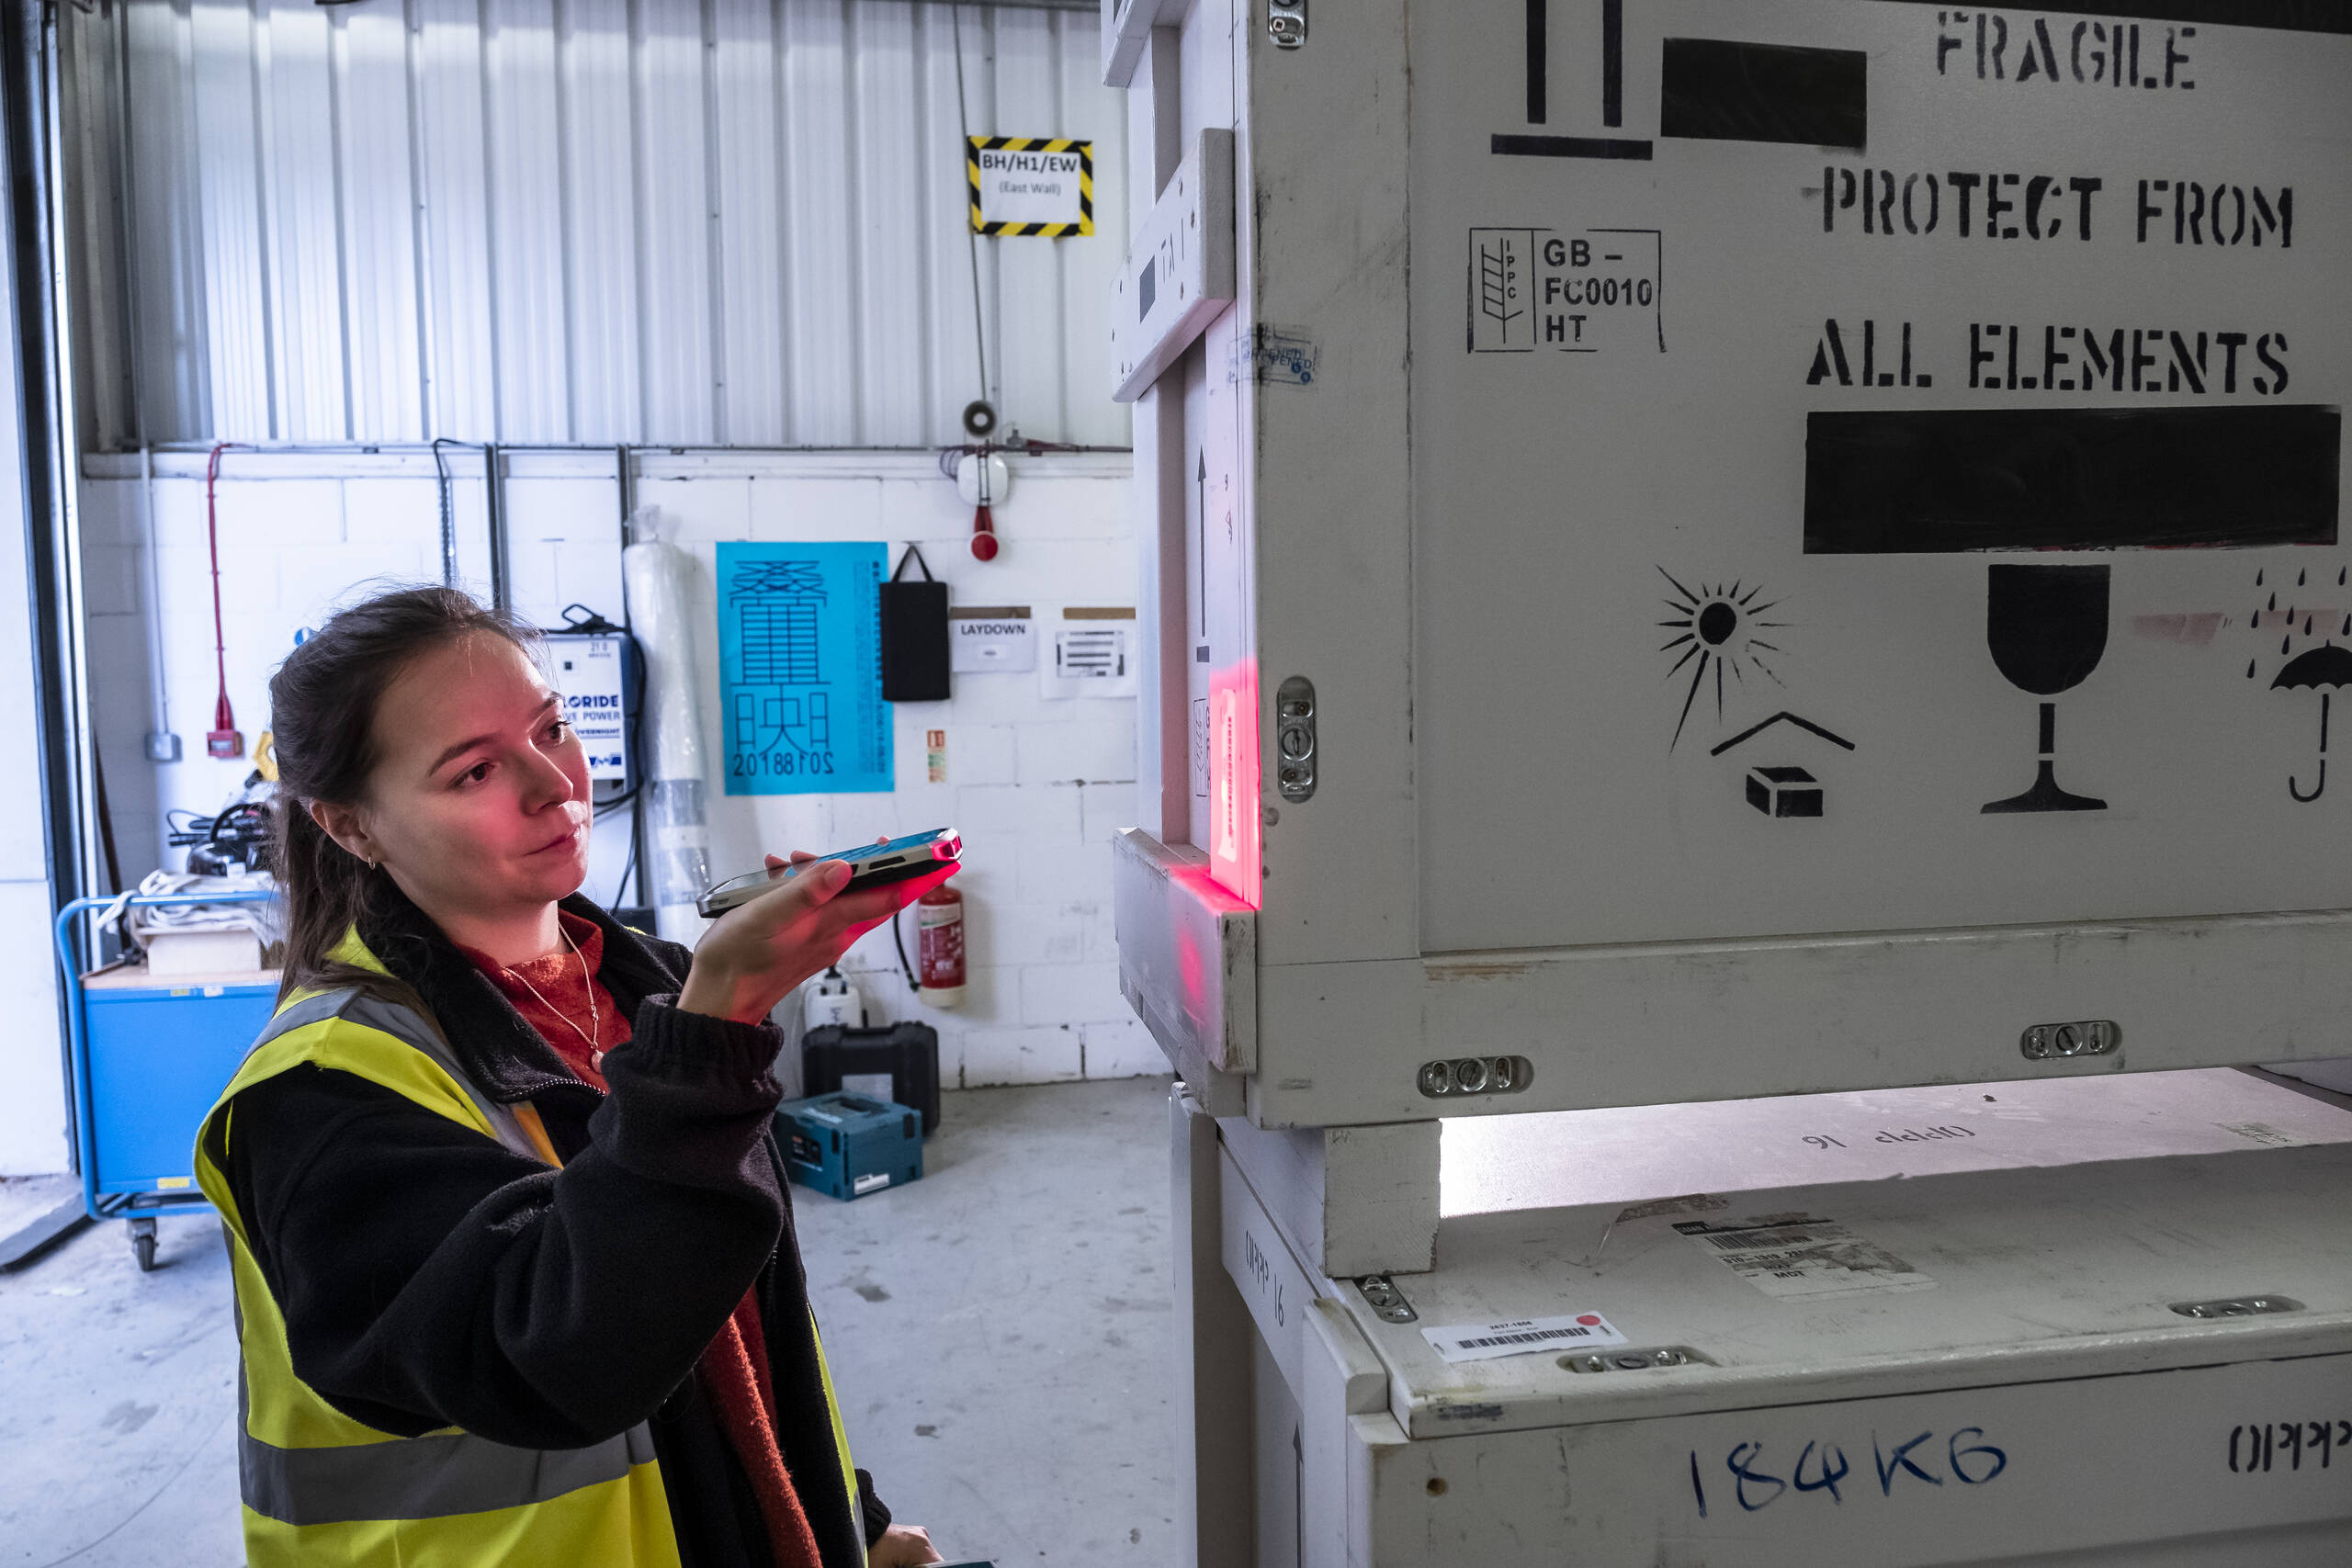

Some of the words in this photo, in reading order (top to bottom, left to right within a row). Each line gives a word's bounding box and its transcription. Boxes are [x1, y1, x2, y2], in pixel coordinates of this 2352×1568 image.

[1937, 10, 2197, 90] FRAGILE
[982, 153, 1078, 174] BH/H1/EW
[1823, 165, 2103, 242] PROTECT
[2136, 178, 2293, 248] FROM
[1544, 238, 1591, 267] GB
[1507, 239, 1517, 299] IPPC
[1544, 276, 1653, 307] FC0010
[1545, 314, 1588, 343] HT
[1805, 318, 1933, 388] ALL
[1968, 323, 2289, 396] ELEMENTS
[960, 624, 1026, 636] LAYDOWN
[582, 711, 620, 721] POWER
